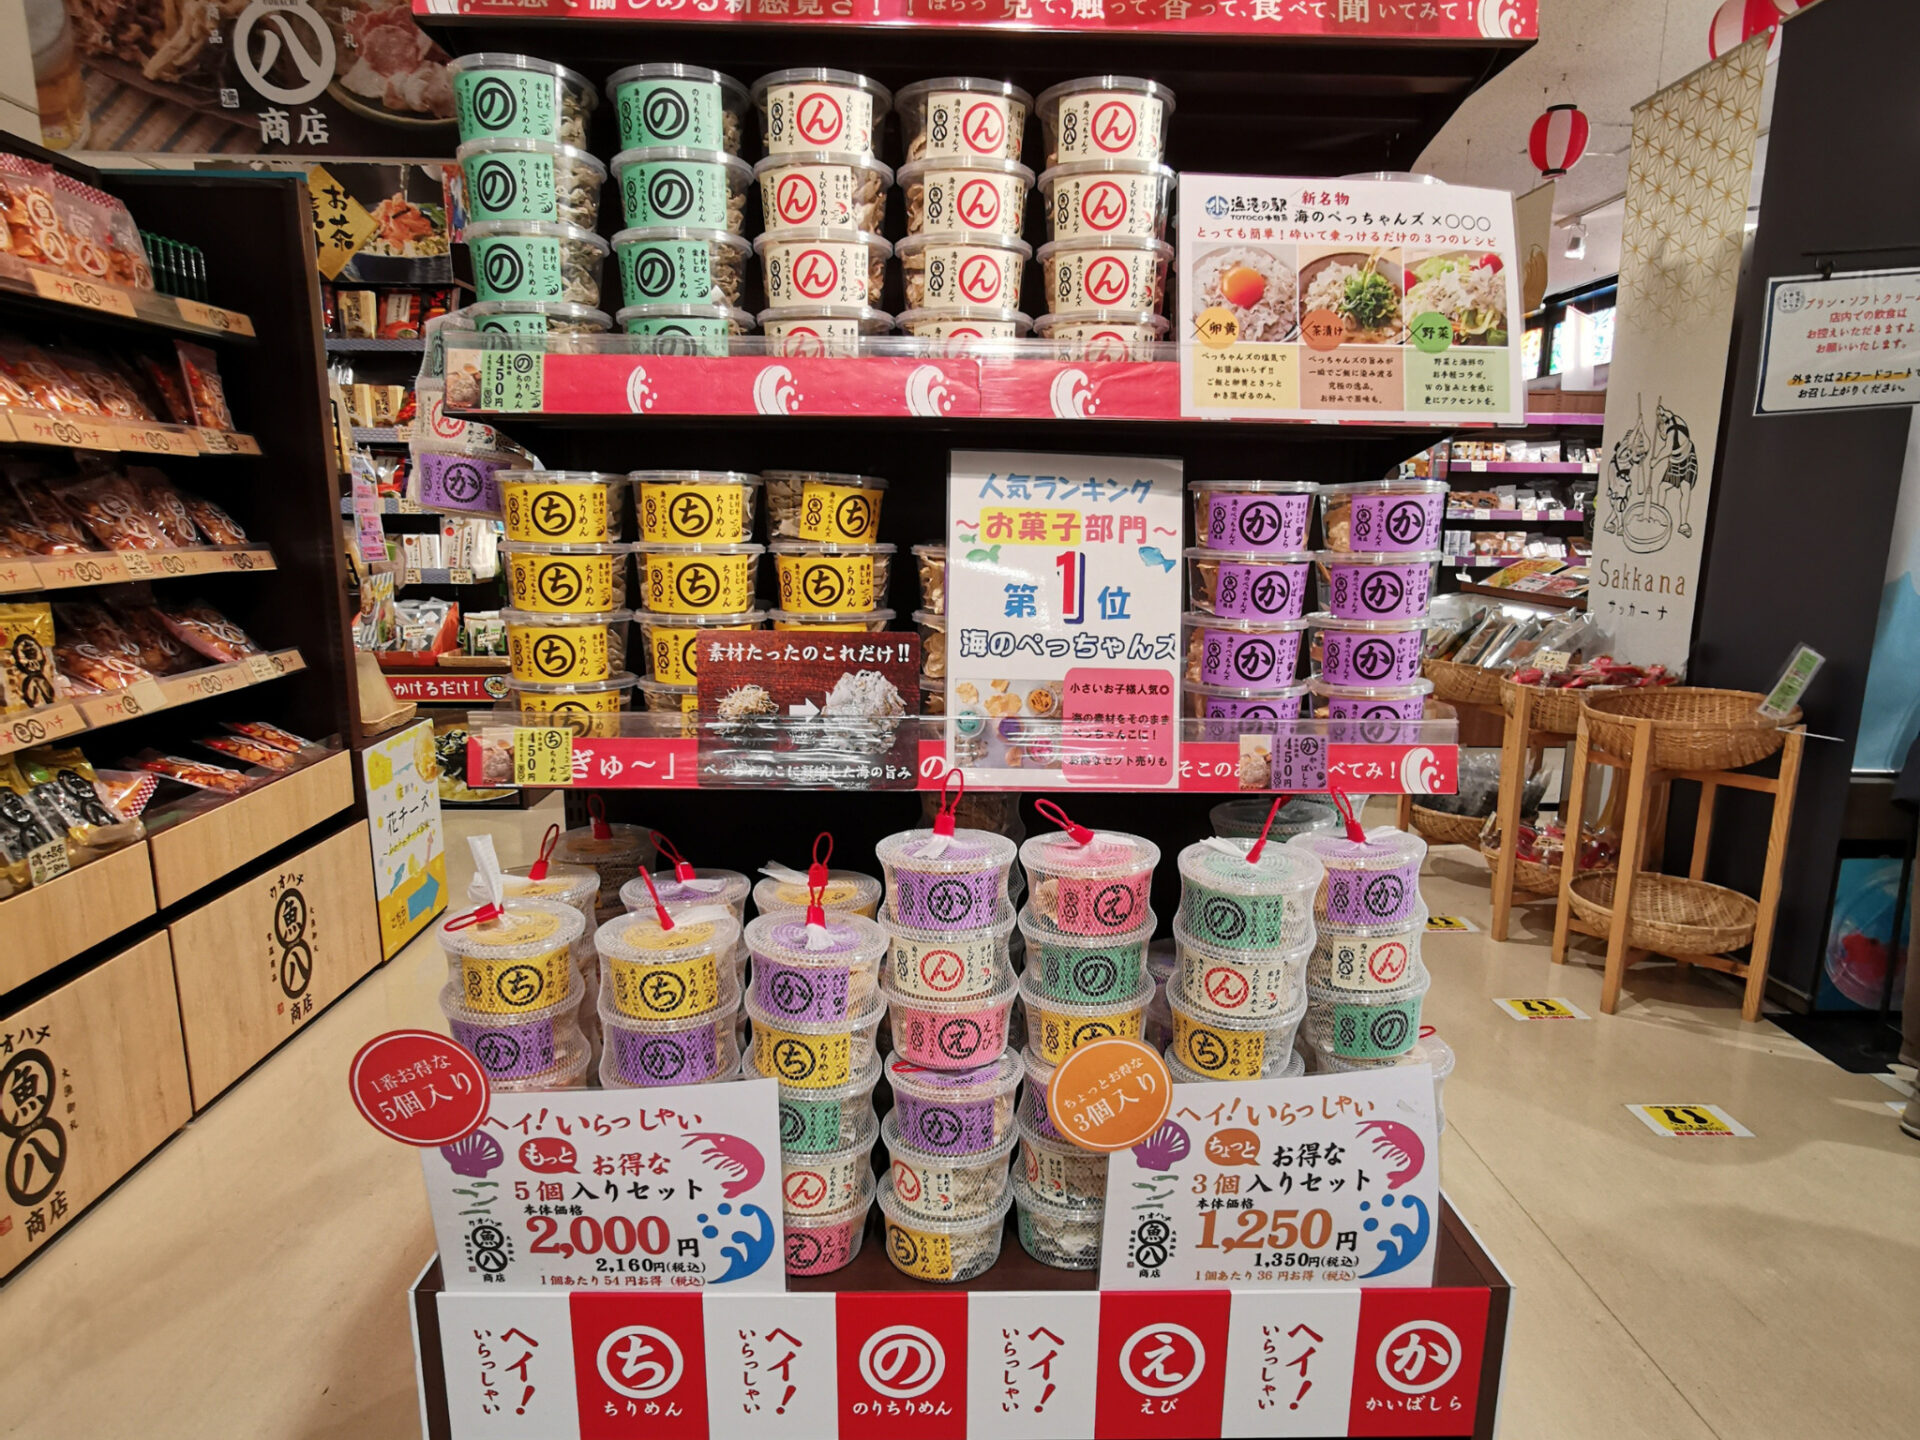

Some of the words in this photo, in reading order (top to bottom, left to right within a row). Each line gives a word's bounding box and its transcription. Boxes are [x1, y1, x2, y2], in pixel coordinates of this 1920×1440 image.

[252, 10, 328, 89] 八
[477, 83, 512, 125] の
[519, 79, 530, 135] のりちりめん
[692, 89, 702, 144] のりちりめん
[801, 98, 838, 140] ん
[257, 107, 330, 147] 商店
[519, 160, 530, 214] のりちりめん
[653, 174, 689, 214] の
[961, 184, 996, 224] ん
[1230, 196, 1288, 212] 漁港の駅
[1302, 192, 1350, 206] 新名物
[1294, 209, 1424, 226] 海のぺっちゃんズ
[1208, 321, 1238, 336] 卵黄
[1311, 324, 1344, 337] 茶漬け
[1422, 326, 1450, 340] 野菜
[1830, 308, 1907, 323] 店内での飲食は
[1434, 358, 1484, 366] 野菜と海鮮の
[1816, 339, 1907, 354] お願いいたします。
[494, 354, 504, 408] 450円
[978, 473, 1154, 504] 人気ランキング
[536, 496, 572, 532] ち
[579, 494, 589, 537] ちりめん
[716, 494, 726, 538] ちりめん
[1243, 505, 1278, 541] か
[1284, 500, 1294, 549] かいばしら
[1390, 505, 1421, 540] か
[722, 564, 732, 608] ちりめん
[807, 568, 840, 602] ち
[1004, 583, 1039, 618] 第
[1056, 550, 1085, 624] 1
[1096, 586, 1131, 620] 位
[1405, 568, 1416, 616] かいばしら
[1598, 558, 1686, 596] Sakkana
[1608, 600, 1668, 621] サッカーナ
[707, 643, 910, 664] 素材たったのこれだけ!!
[960, 629, 1175, 660] 海のぺっちゃんズ
[1238, 643, 1271, 677] か
[393, 681, 479, 696] かけるだけ！
[528, 732, 536, 782] 450円
[1284, 738, 1292, 788] 450円
[932, 884, 968, 918] か
[1098, 888, 1130, 922] え
[1207, 901, 1243, 936] の
[924, 954, 960, 987] ん
[1373, 946, 1403, 979] ん
[502, 969, 538, 1002] ち
[290, 993, 313, 1024] 商店
[371, 1054, 451, 1095] 1番お得な
[1063, 1058, 1144, 1110] ちょっとお得な
[378, 1072, 474, 1123] 5個入り
[1073, 1072, 1158, 1134] 3個入り
[524, 1144, 575, 1167] もっと
[593, 1152, 671, 1176] お得な
[1208, 1136, 1258, 1159] ちょっと
[1272, 1142, 1346, 1167] お得な
[514, 1180, 704, 1202] 5個入りセット
[1191, 1169, 1372, 1194] 3個入りセット
[24, 1190, 68, 1242] 商店
[524, 1204, 584, 1215] 本体価格
[1196, 1198, 1254, 1209] 本体価格
[526, 1216, 670, 1259] 2,000
[676, 1238, 700, 1258] 円
[1195, 1208, 1332, 1254] 1,250
[1336, 1231, 1358, 1252] 円
[596, 1258, 706, 1273] 2,160円(税込)
[1138, 1268, 1161, 1278] 商店
[1254, 1252, 1360, 1268] 1,350円(税込)
[482, 1273, 506, 1283] 商店
[472, 1328, 501, 1416] いらっしゃい
[500, 1326, 539, 1417] ヘイ！
[612, 1331, 670, 1392] ち
[739, 1328, 760, 1416] いらっしゃい
[764, 1326, 803, 1417] ヘイ！
[868, 1335, 935, 1389] の
[1001, 1326, 1021, 1414] いらっしゃい
[1027, 1324, 1065, 1414] ヘイ！
[1135, 1329, 1191, 1390] え
[1256, 1324, 1280, 1411] いらっしゃい
[1286, 1323, 1324, 1411] ヘイ！
[1388, 1329, 1452, 1385] か
[604, 1402, 684, 1417] ちりめん
[852, 1400, 953, 1416] のりちりめん
[1140, 1397, 1179, 1415] えび
[1366, 1396, 1464, 1414] かいばしら
